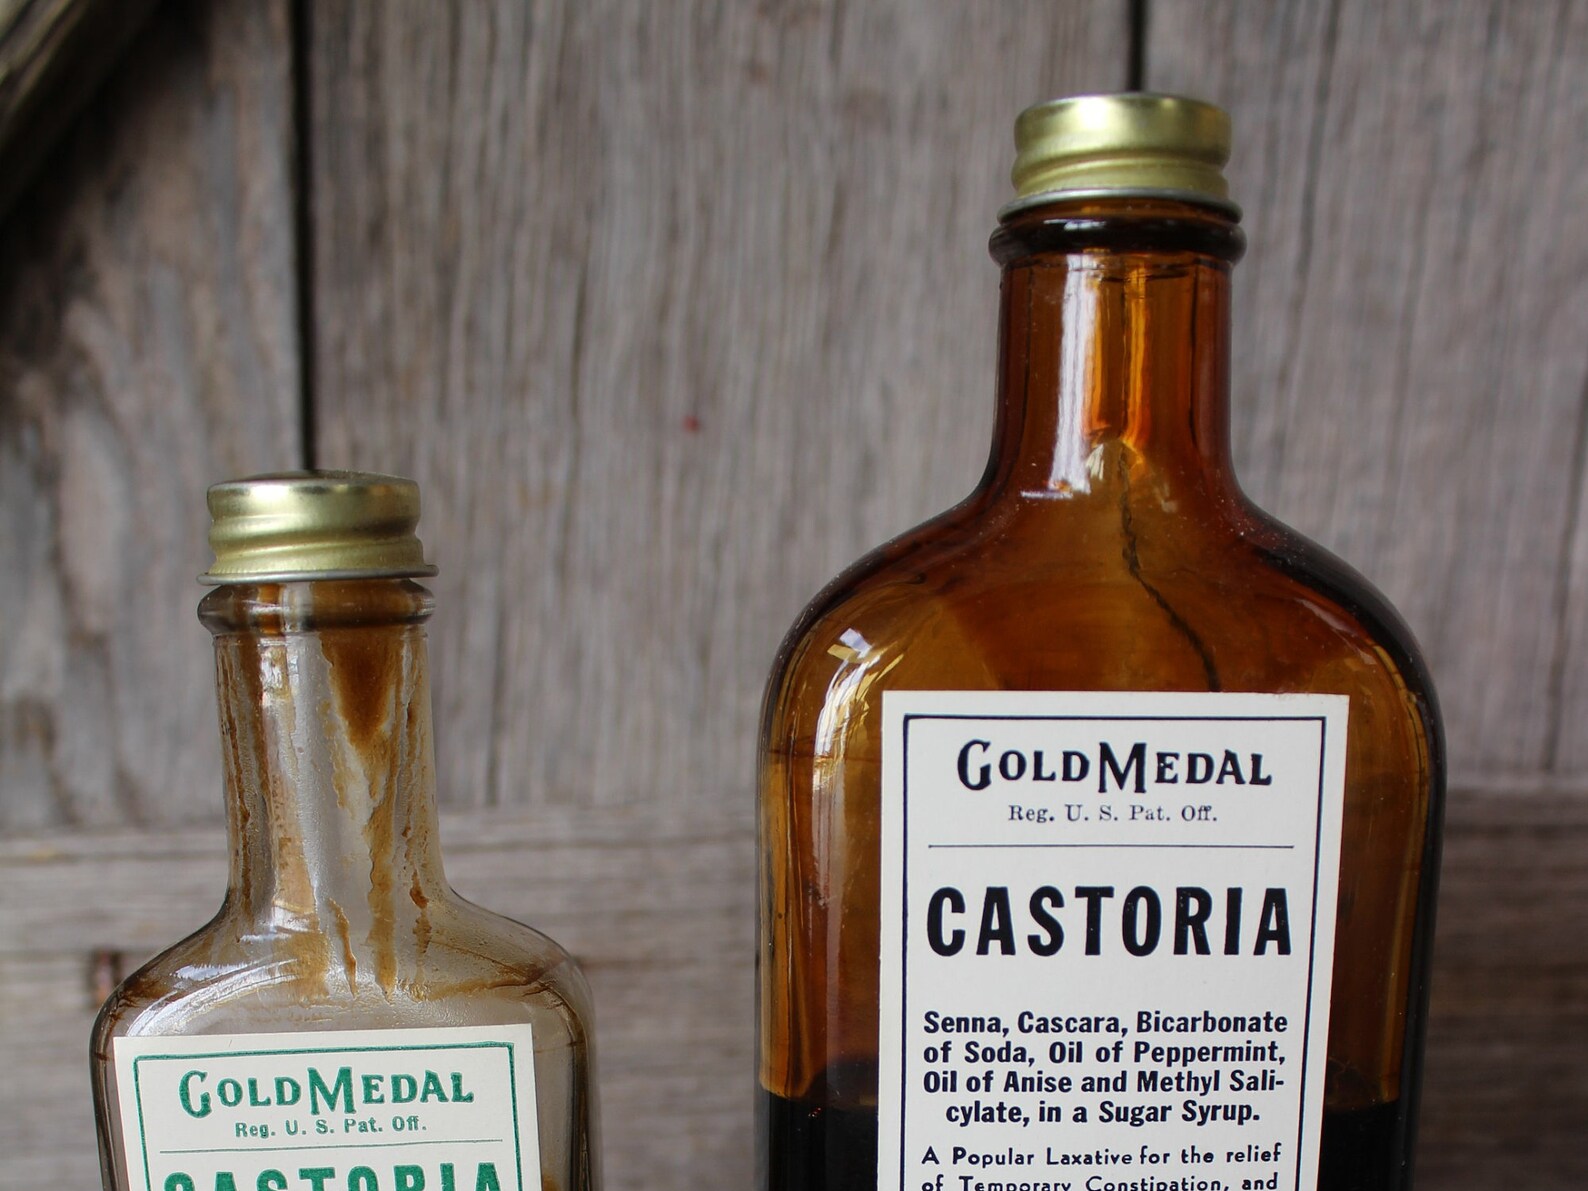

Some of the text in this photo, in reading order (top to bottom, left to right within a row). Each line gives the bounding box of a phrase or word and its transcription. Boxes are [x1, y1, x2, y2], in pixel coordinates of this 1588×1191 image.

[1009, 805, 1054, 823] Reg.
[1065, 804, 1088, 821] U.
[1099, 806, 1118, 821] S.
[1130, 805, 1170, 821] Pat.
[927, 885, 1291, 957] CASTORIA
[924, 1010, 1288, 1038] Senna, Cascara, Bicarbonate
[924, 1040, 1285, 1067] of Soda, Oil of Peppermint,
[924, 1069, 1284, 1096] Oil of Anise and Methyl Sali-
[946, 1100, 1260, 1127] cylate, in a Sugar Syrup.
[235, 1123, 275, 1139] Reg.
[285, 1120, 306, 1136] U.
[316, 1119, 334, 1134] S.
[344, 1117, 383, 1133] Pat.
[921, 1142, 1282, 1169] A Popular Laxative for the relief
[1242, 1172, 1278, 1190] and
